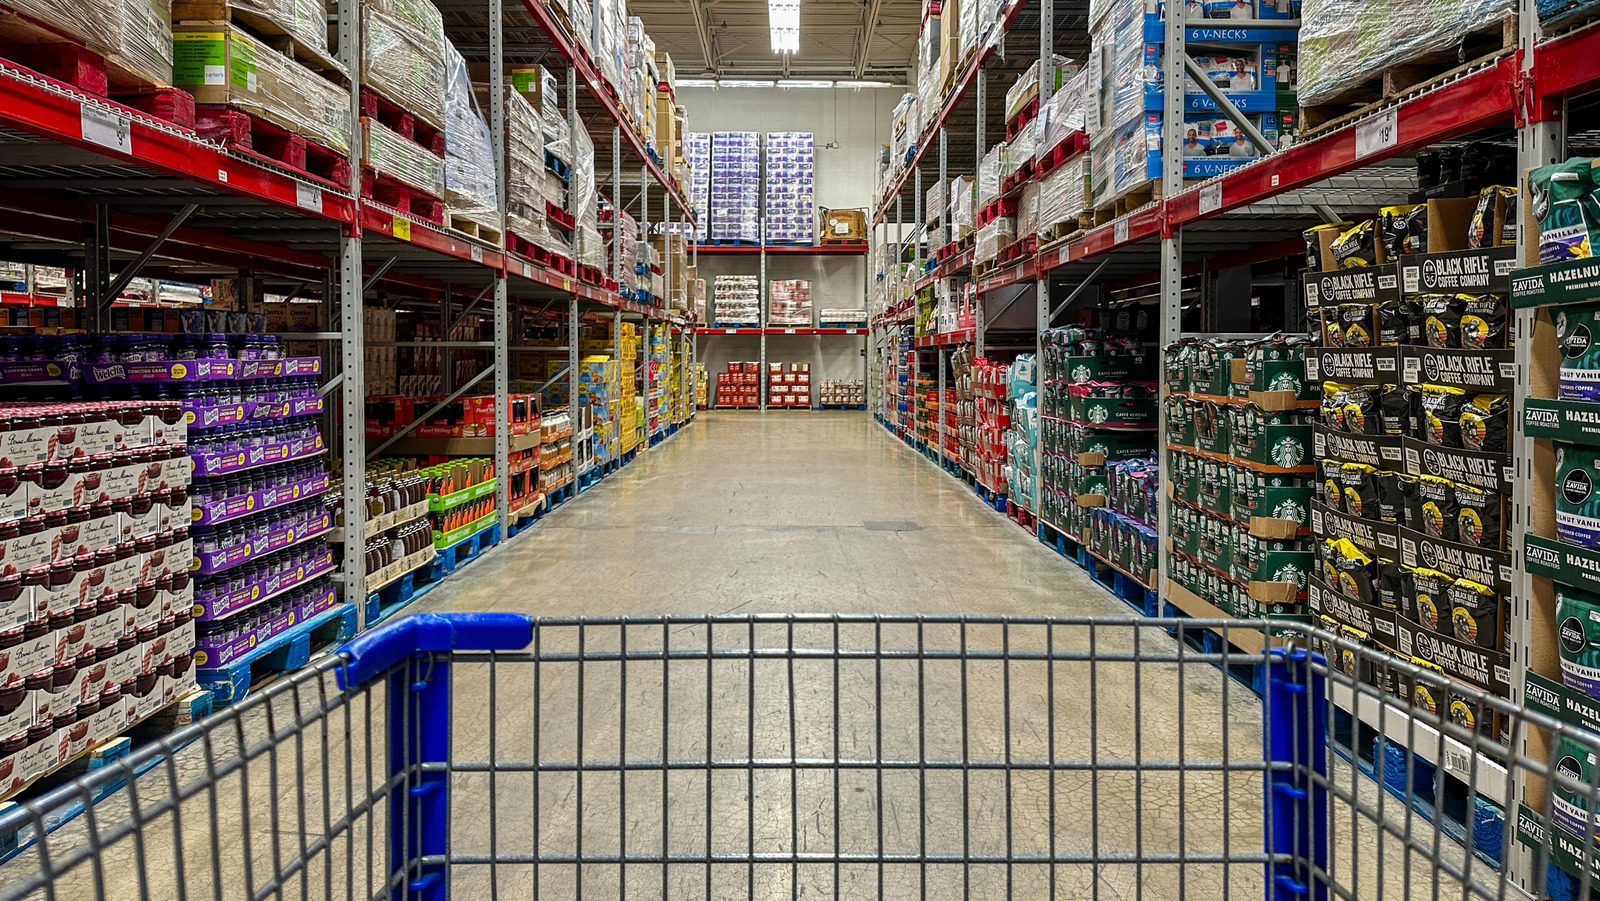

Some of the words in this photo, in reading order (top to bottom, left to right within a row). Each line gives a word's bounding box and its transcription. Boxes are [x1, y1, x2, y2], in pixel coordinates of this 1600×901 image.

[1192, 30, 1199, 39] 6
[1202, 30, 1247, 39] V-NECKS
[1192, 99, 1198, 108] 6
[1194, 165, 1200, 174] 6
[1543, 228, 1579, 240] VANILLA
[1436, 258, 1462, 276] BLACK
[1463, 256, 1489, 274] RIFLE
[1332, 274, 1354, 290] BLACK
[1353, 273, 1374, 289] RIFLE
[1438, 276, 1458, 288] COFFEE
[1460, 274, 1490, 287] COMPANY
[1512, 280, 1544, 292] ZAVIDA
[1565, 283, 1588, 291] PREMIUM
[1335, 290, 1352, 300] COFFEE
[1352, 288, 1376, 299] COMPANY
[1513, 290, 1527, 298] COFFEE
[1333, 353, 1354, 367] BLACK
[1353, 353, 1373, 368] RIFLE
[1437, 355, 1466, 373] BLACK
[1465, 357, 1493, 374] RIFLE
[97, 366, 123, 379] Welch's
[1335, 368, 1352, 378] COFFEE
[1352, 368, 1374, 378] COMPANY
[1440, 372, 1462, 384] COFFEE
[1463, 373, 1495, 386] COMPANY
[1526, 410, 1559, 423] ZAVIDA
[1335, 435, 1357, 452] BLACK
[1354, 440, 1377, 455] RIFLE
[1340, 450, 1357, 461] COFFEE
[1356, 452, 1380, 465] COMPANY
[1437, 452, 1468, 472] BLACK
[1466, 457, 1497, 477] RIFLE
[1442, 468, 1466, 483] COFFEE
[1465, 473, 1498, 489] COMPANY
[1566, 481, 1587, 492] ZAVIDA
[1333, 515, 1355, 534] BLACK
[1353, 521, 1374, 539] RIFLE
[1353, 534, 1376, 550] COMPANY
[1435, 544, 1465, 566] BLACK
[1465, 551, 1494, 574] RIFLE
[1526, 546, 1560, 564] ZAVIDA
[1526, 556, 1540, 565] COFFEE
[1439, 560, 1462, 577] COFFEE
[1462, 568, 1494, 586] COMPANY
[1455, 590, 1467, 600] BLACK
[1467, 594, 1478, 603] RIFLE
[1331, 594, 1352, 616] BLACK
[1350, 603, 1371, 624] RIFLE
[1335, 607, 1351, 623] COFFEE
[1350, 616, 1373, 634] COMPANY
[1562, 627, 1581, 640] ZAVIDA
[1430, 637, 1461, 663] BLACK
[1460, 648, 1488, 673] RIFLE
[1434, 653, 1457, 672] COFFEE
[1457, 663, 1489, 685] COMPANY
[1526, 684, 1560, 706] ZAVIDA
[1526, 694, 1540, 705] COFFEE
